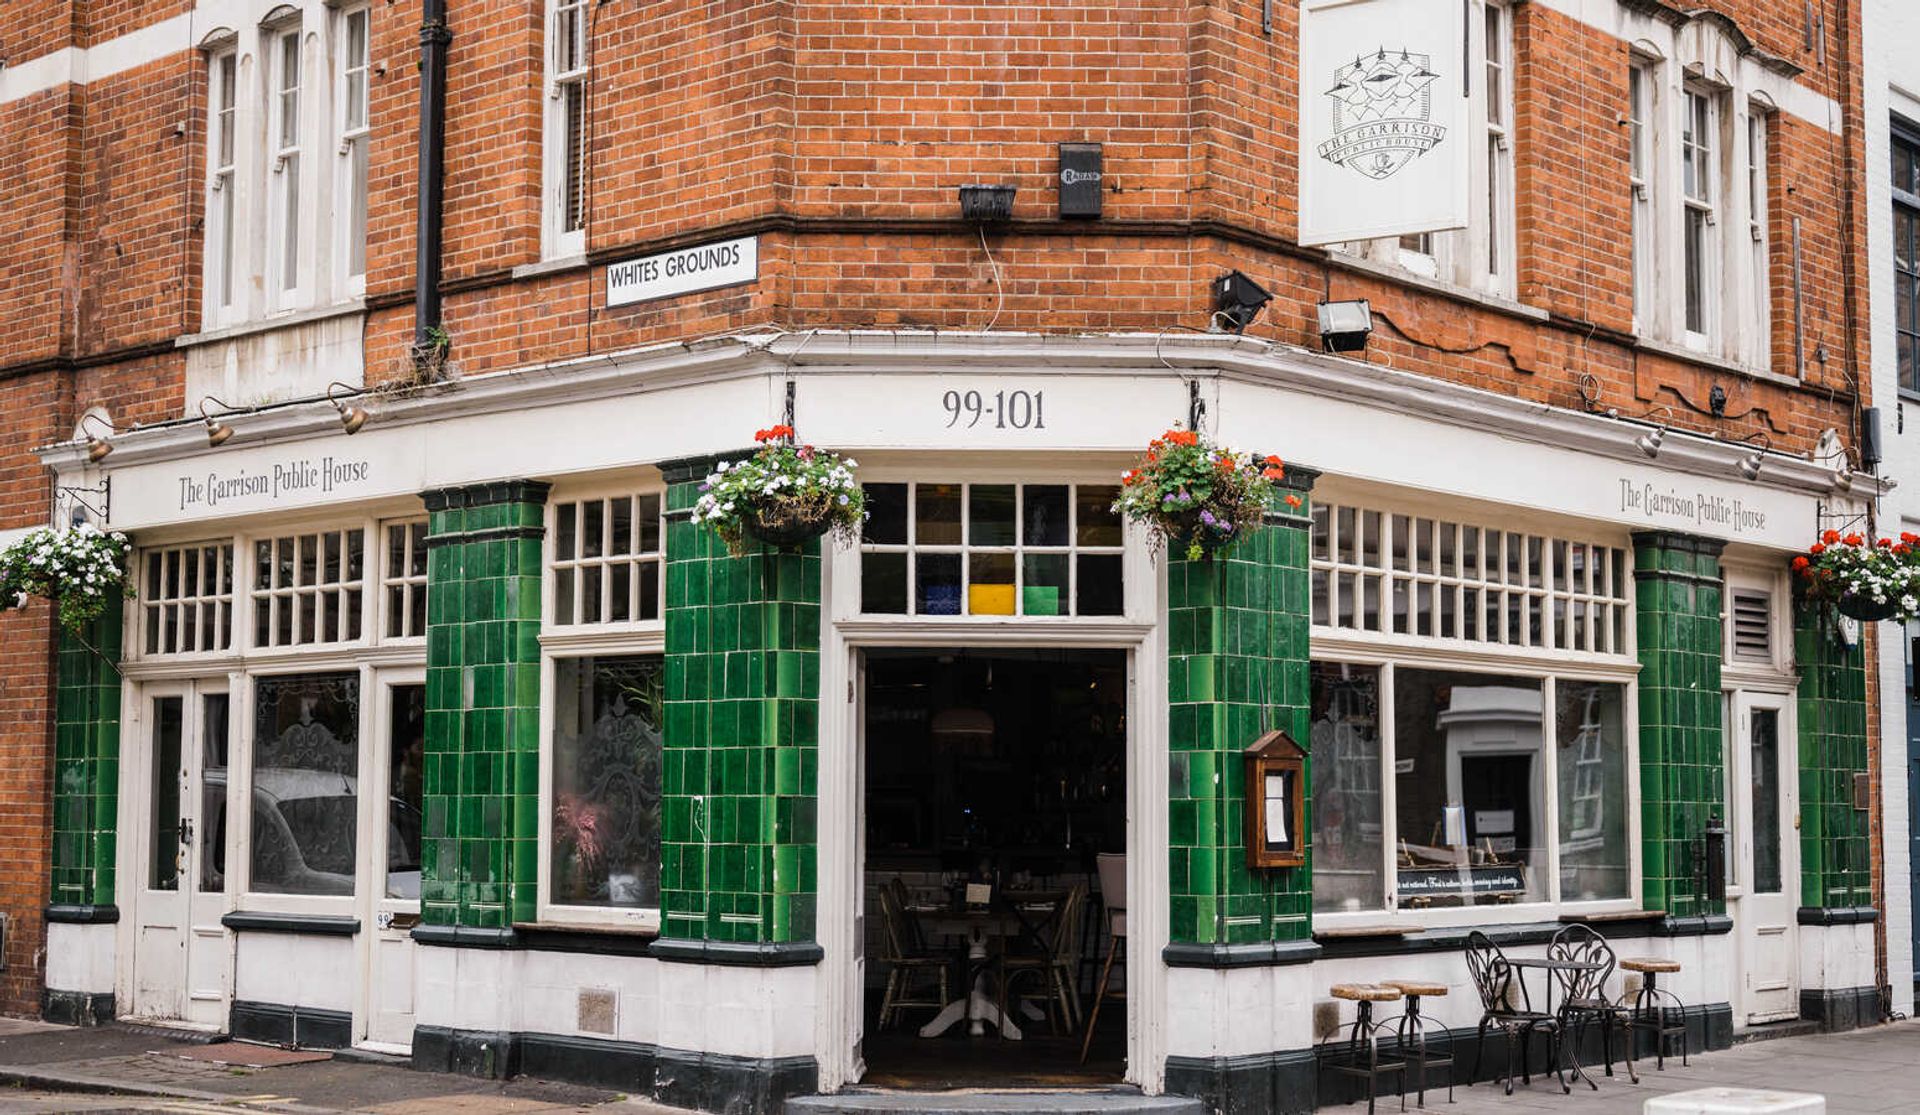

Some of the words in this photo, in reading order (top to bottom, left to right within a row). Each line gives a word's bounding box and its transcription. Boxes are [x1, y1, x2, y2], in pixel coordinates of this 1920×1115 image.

[1321, 133, 1349, 152] THE
[1357, 122, 1442, 139] GARRISON
[610, 260, 658, 288] WHITES
[665, 244, 740, 277] GROUNDS
[942, 390, 1045, 428] 99-101
[179, 477, 204, 510] The
[207, 469, 268, 506] Garrison
[273, 460, 317, 497] Public
[323, 457, 368, 492] House
[1619, 478, 1641, 512] The
[1644, 484, 1694, 518] Garrison
[1697, 494, 1731, 525] Public
[1733, 500, 1766, 532] House
